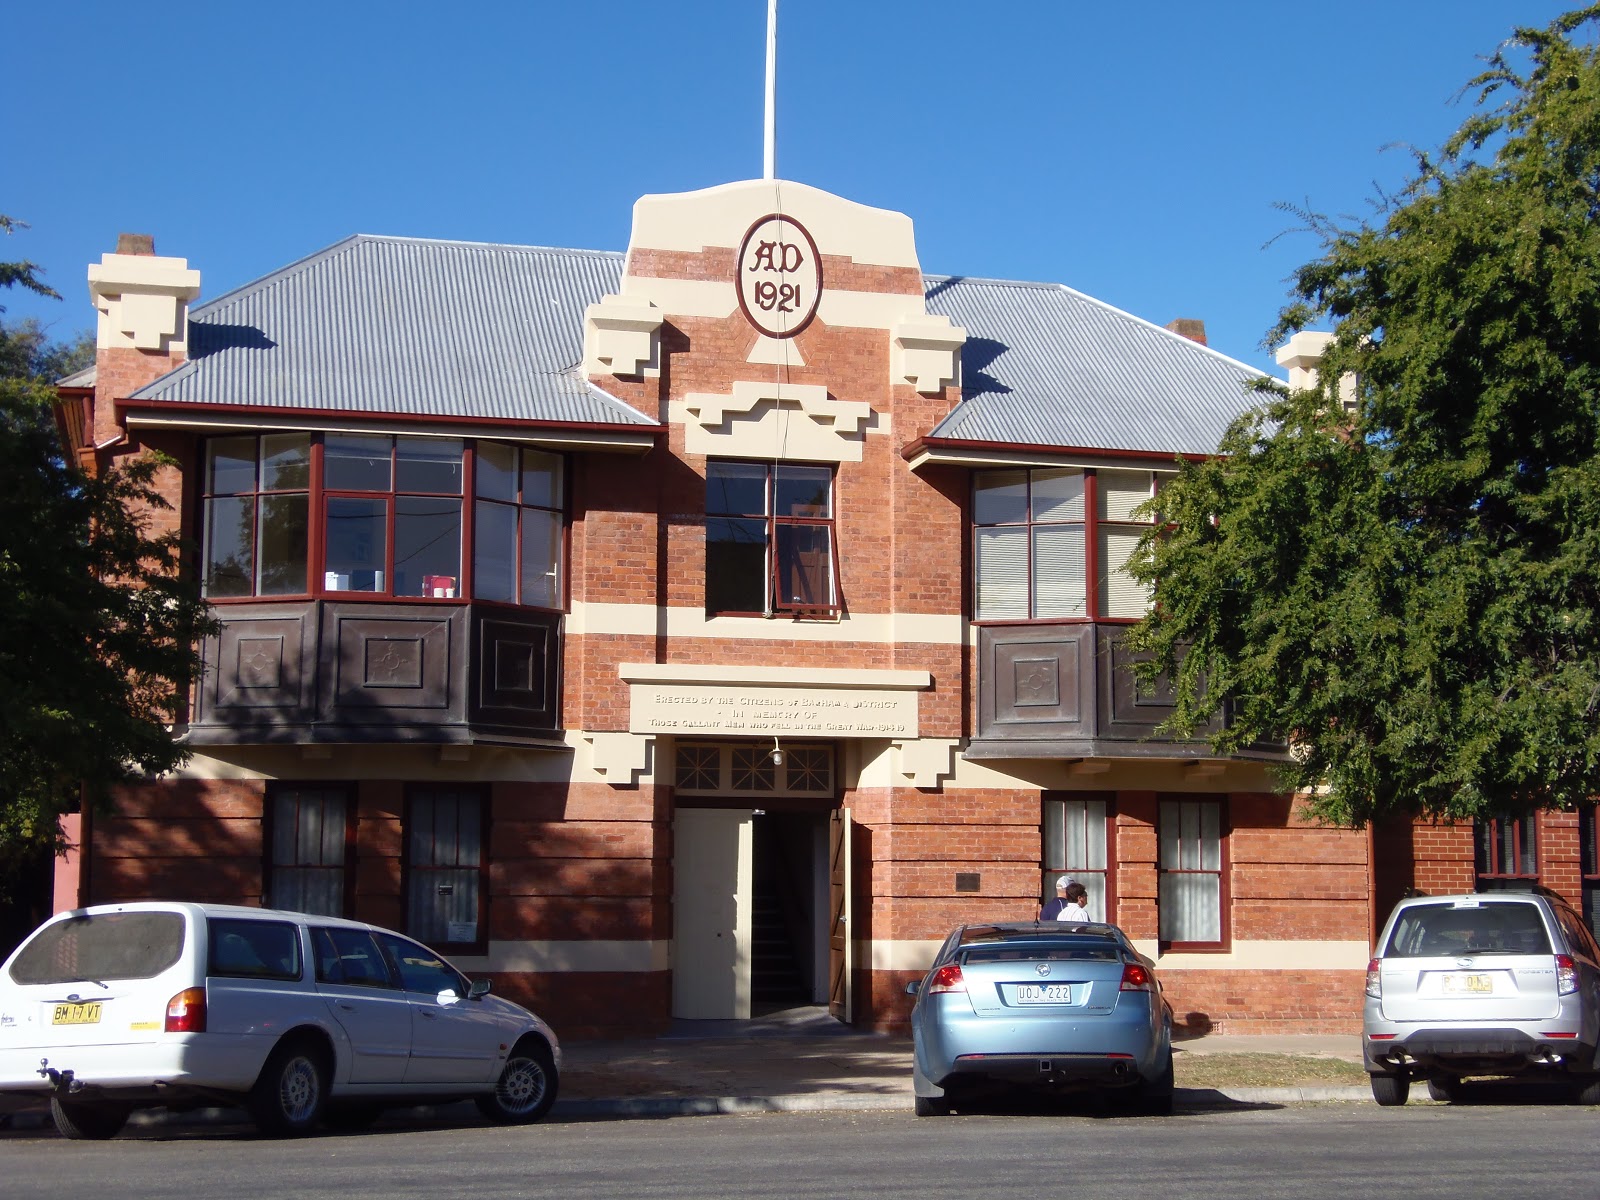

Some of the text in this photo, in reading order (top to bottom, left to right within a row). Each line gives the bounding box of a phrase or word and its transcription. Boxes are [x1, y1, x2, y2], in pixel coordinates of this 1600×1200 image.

[749, 240, 804, 273] AD
[755, 281, 801, 313] 1921
[655, 694, 699, 704] ERECTED
[701, 697, 714, 705] BY
[716, 697, 734, 705] THE
[740, 697, 784, 706] CITIZENS
[853, 700, 898, 709] DISTRICT
[733, 710, 818, 720] IN MEMORY OF
[649, 719, 678, 728] THOSE
[682, 720, 721, 729] GALLANT
[724, 721, 745, 729] MEN
[806, 723, 822, 731] THE
[826, 723, 853, 731] GREAT
[1048, 987, 1069, 999] 222
